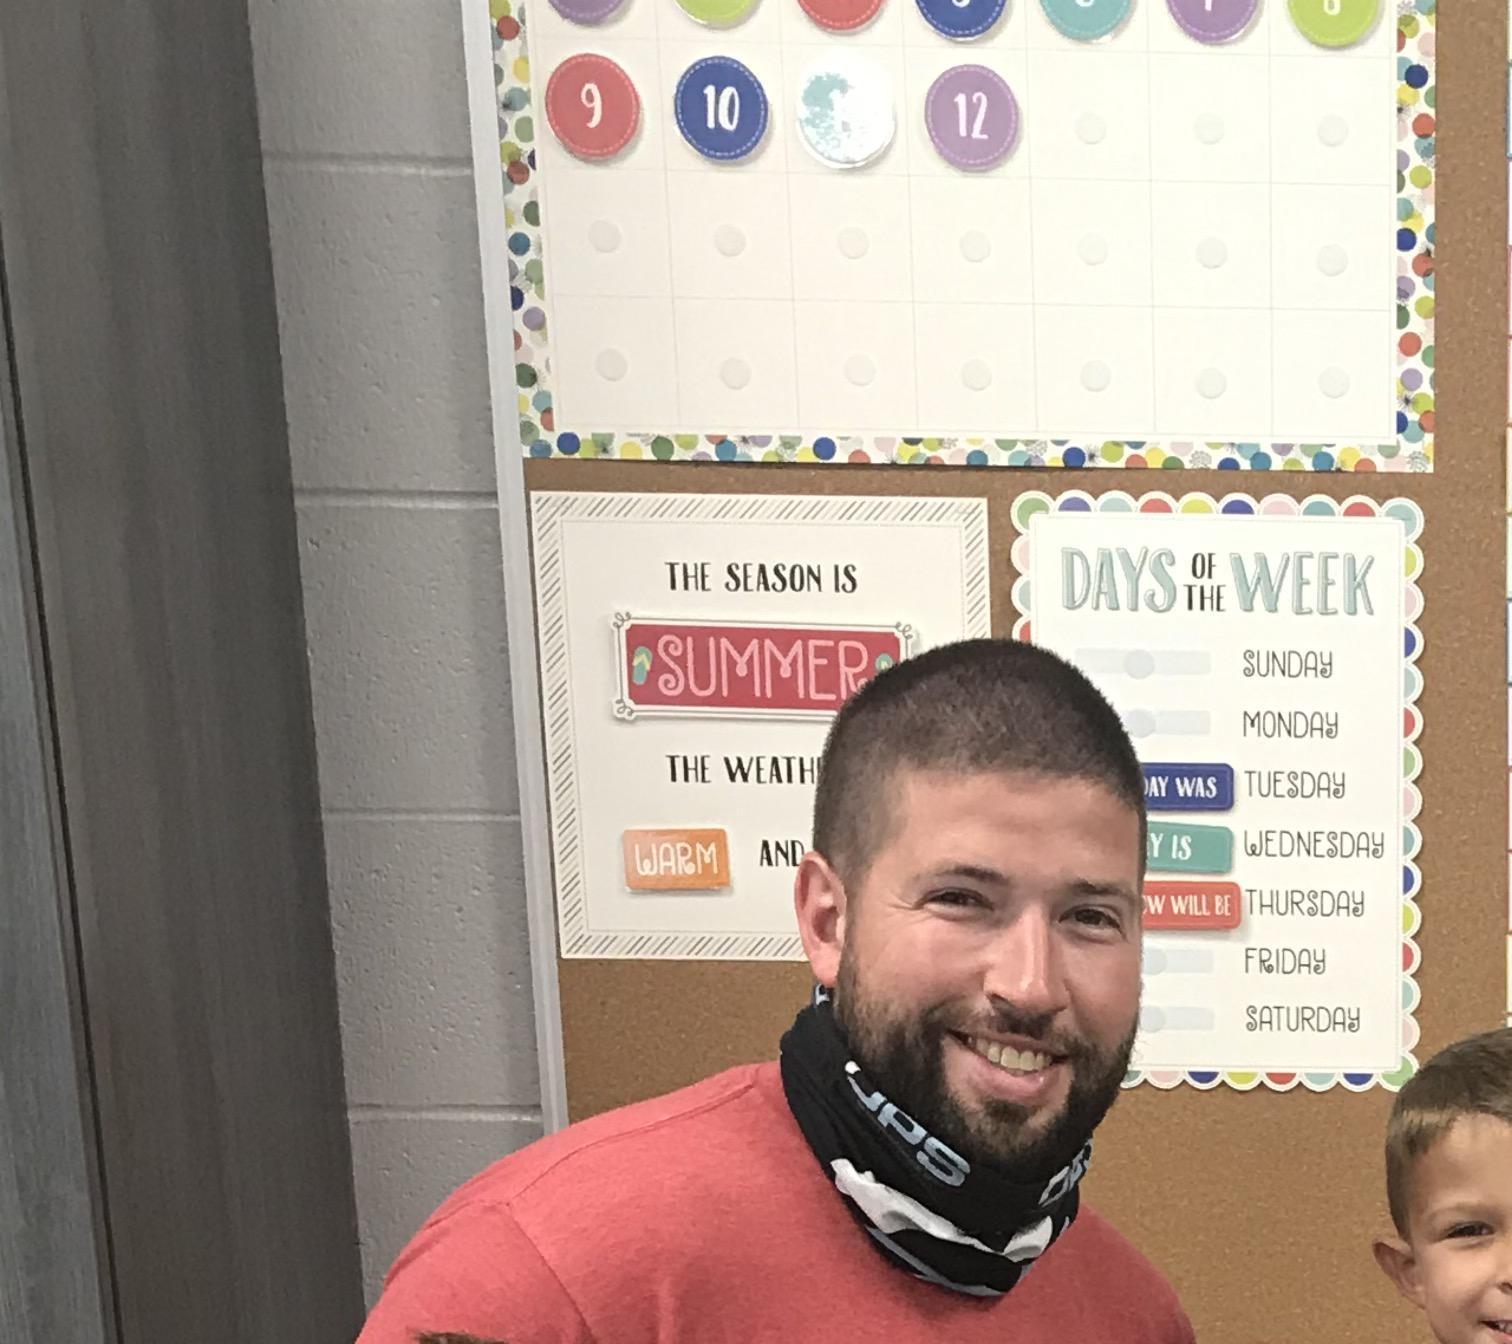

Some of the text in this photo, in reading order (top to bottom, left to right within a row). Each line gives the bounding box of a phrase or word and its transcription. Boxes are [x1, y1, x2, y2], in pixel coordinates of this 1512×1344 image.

[580, 83, 602, 128] 9
[703, 85, 740, 131] 10
[954, 92, 988, 140] 12
[665, 562, 858, 594] THE SEASON IS
[1060, 546, 1376, 616] DAYS OF THE WEEK
[657, 633, 869, 700] SUMMER
[1242, 650, 1333, 679] SUNDAY
[1242, 710, 1339, 739] MONDAY
[666, 755, 712, 784] THE
[1176, 776, 1217, 798] WAS
[1244, 770, 1346, 800] TUESDAY
[634, 839, 805, 876] WARM AND
[1171, 834, 1192, 861] IS
[1243, 830, 1385, 860] WEDNESDAY
[1171, 895, 1211, 916] WILL
[1214, 895, 1231, 916] BE
[1245, 888, 1365, 918] THURSDAY
[1244, 947, 1327, 976] FRIDAY
[1245, 1005, 1361, 1034] SATURDAY
